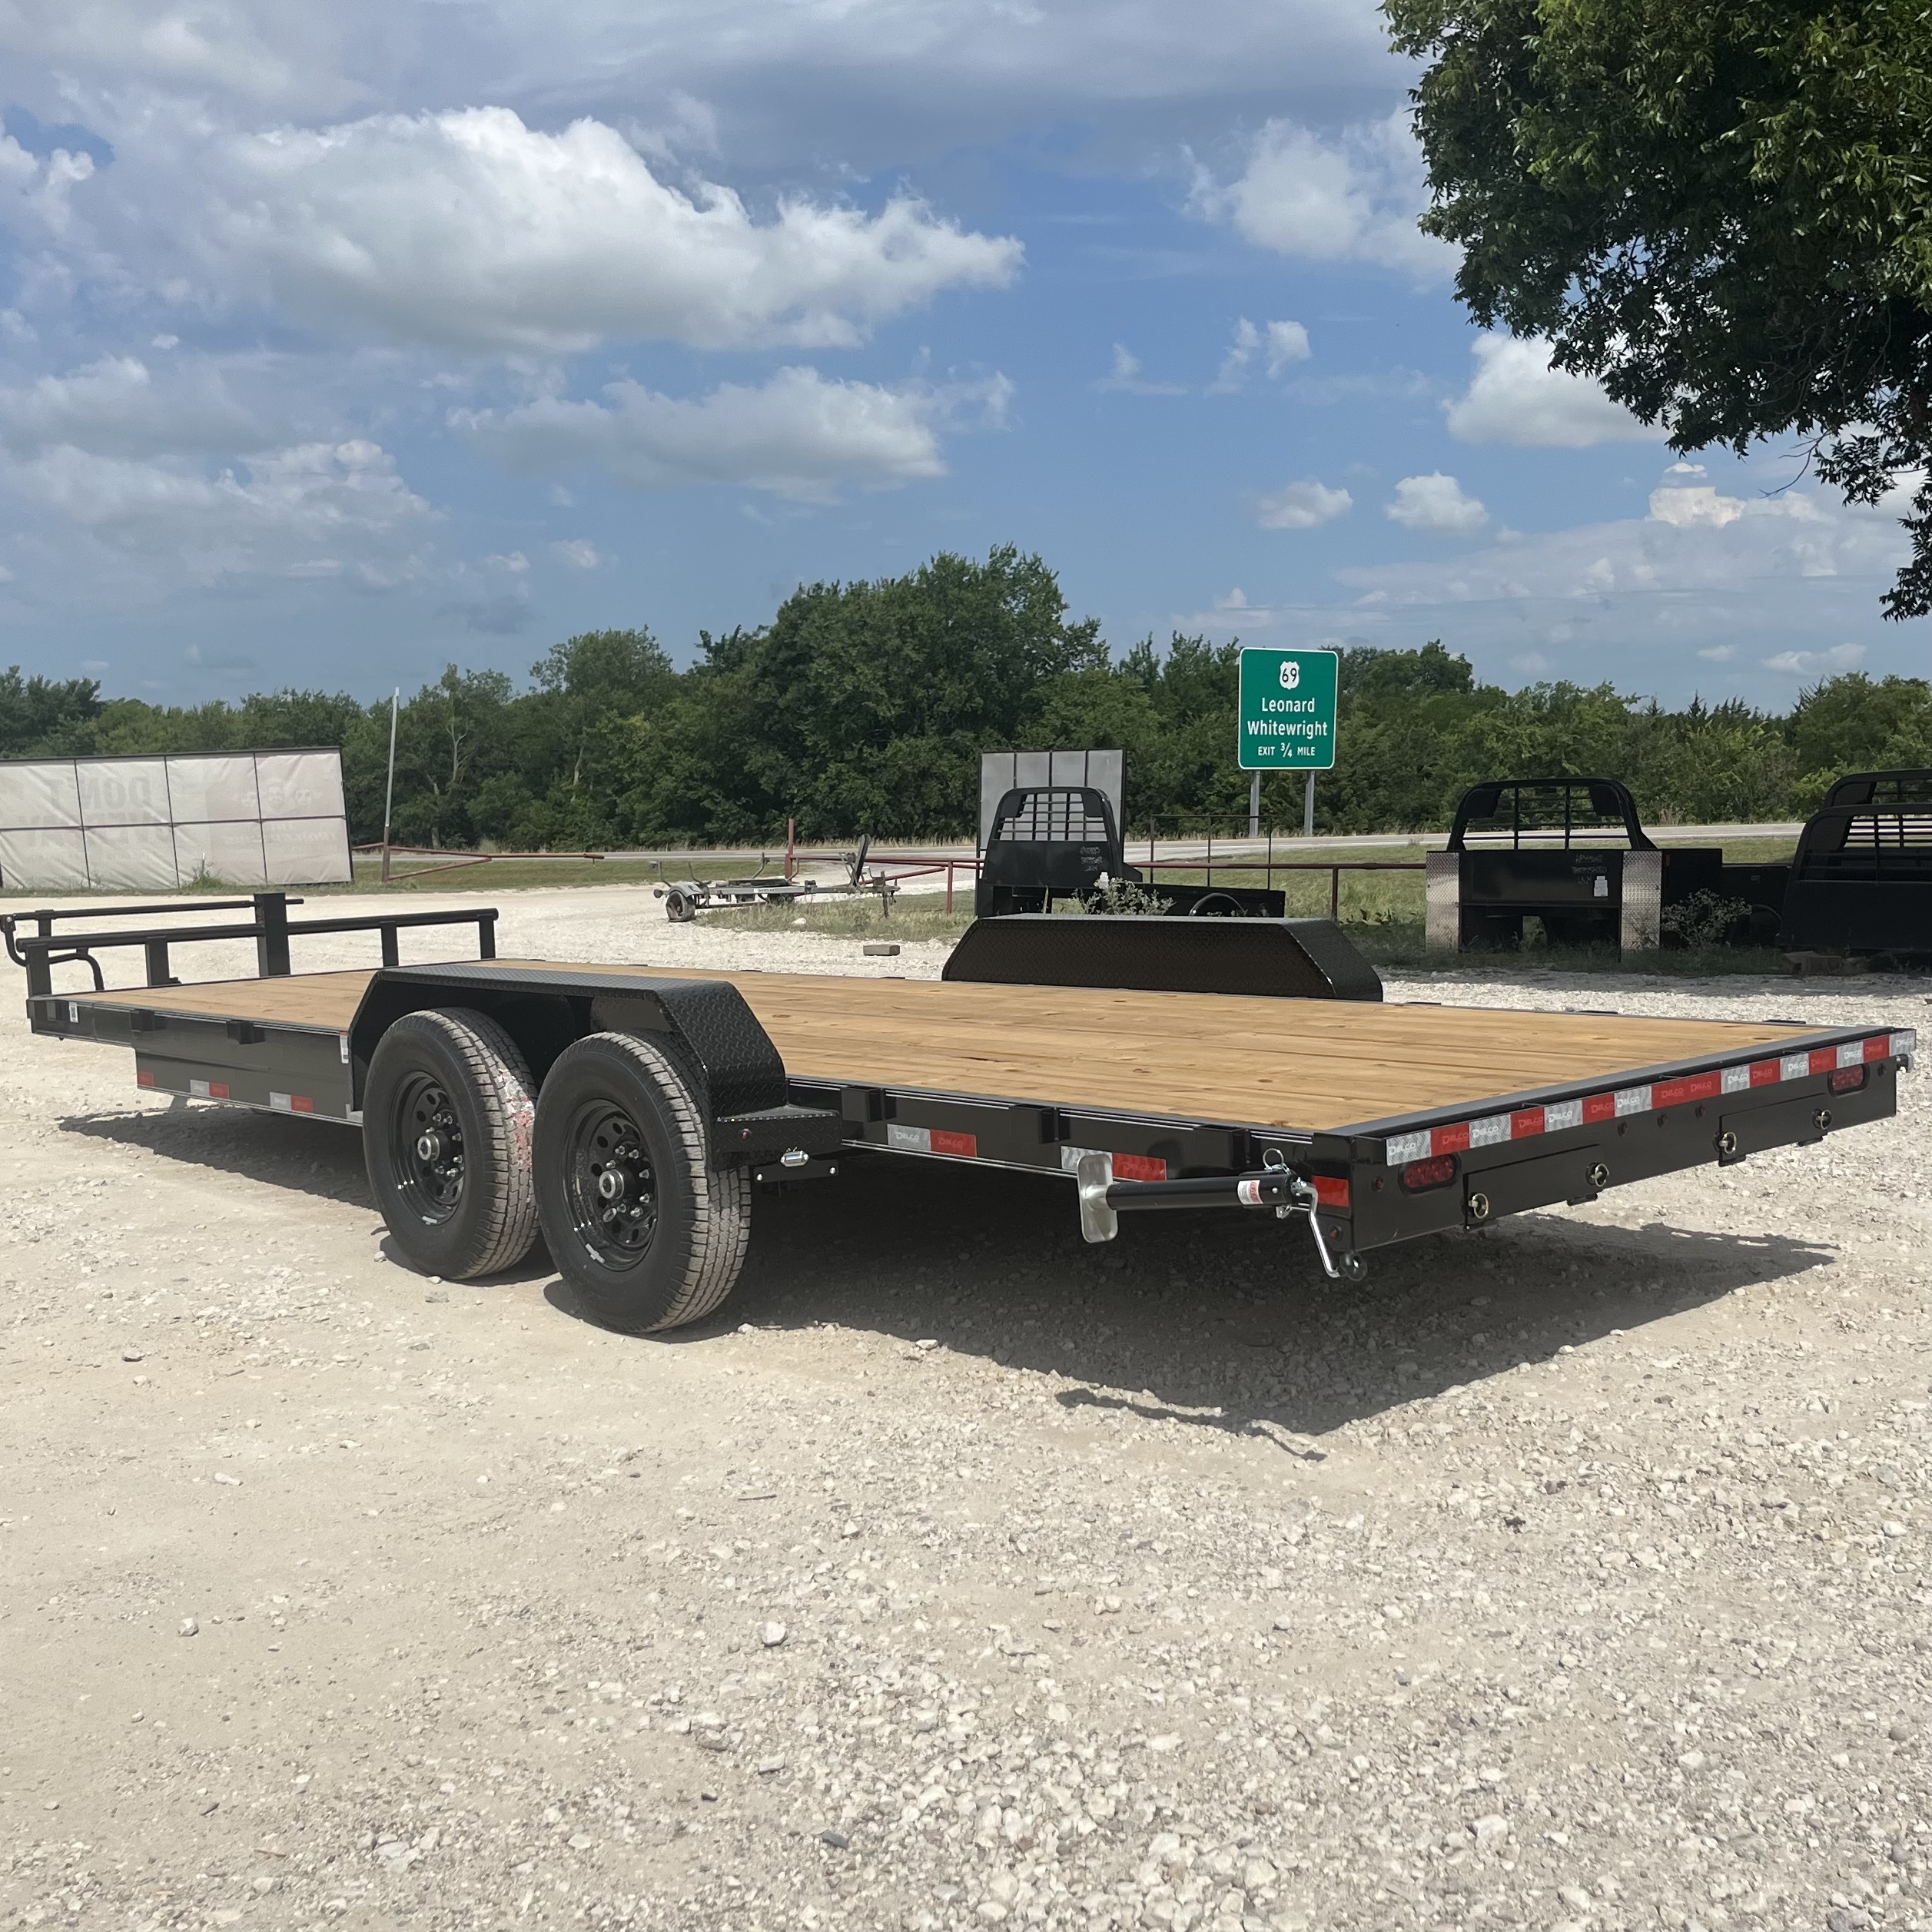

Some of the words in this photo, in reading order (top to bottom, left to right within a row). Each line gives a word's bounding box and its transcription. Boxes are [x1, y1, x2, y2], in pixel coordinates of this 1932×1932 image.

[1281, 667, 1297, 683] 69
[1261, 697, 1316, 713] Leonard
[1247, 719, 1328, 740] Whitewright
[1257, 745, 1276, 756] EXIT
[1296, 746, 1316, 756] MILE
[1661, 1087, 1685, 1099] DELCO
[1690, 1081, 1712, 1092] DELCO
[1590, 1101, 1614, 1114] DELCO
[1616, 1096, 1640, 1108] DELCO
[1518, 1116, 1544, 1128] DELCO
[1548, 1110, 1573, 1123] DELCO
[895, 1131, 920, 1141] DELCO
[1442, 1131, 1469, 1145] DELCO
[1472, 1125, 1499, 1139] DELCO
[1388, 1142, 1416, 1156] DELCO
